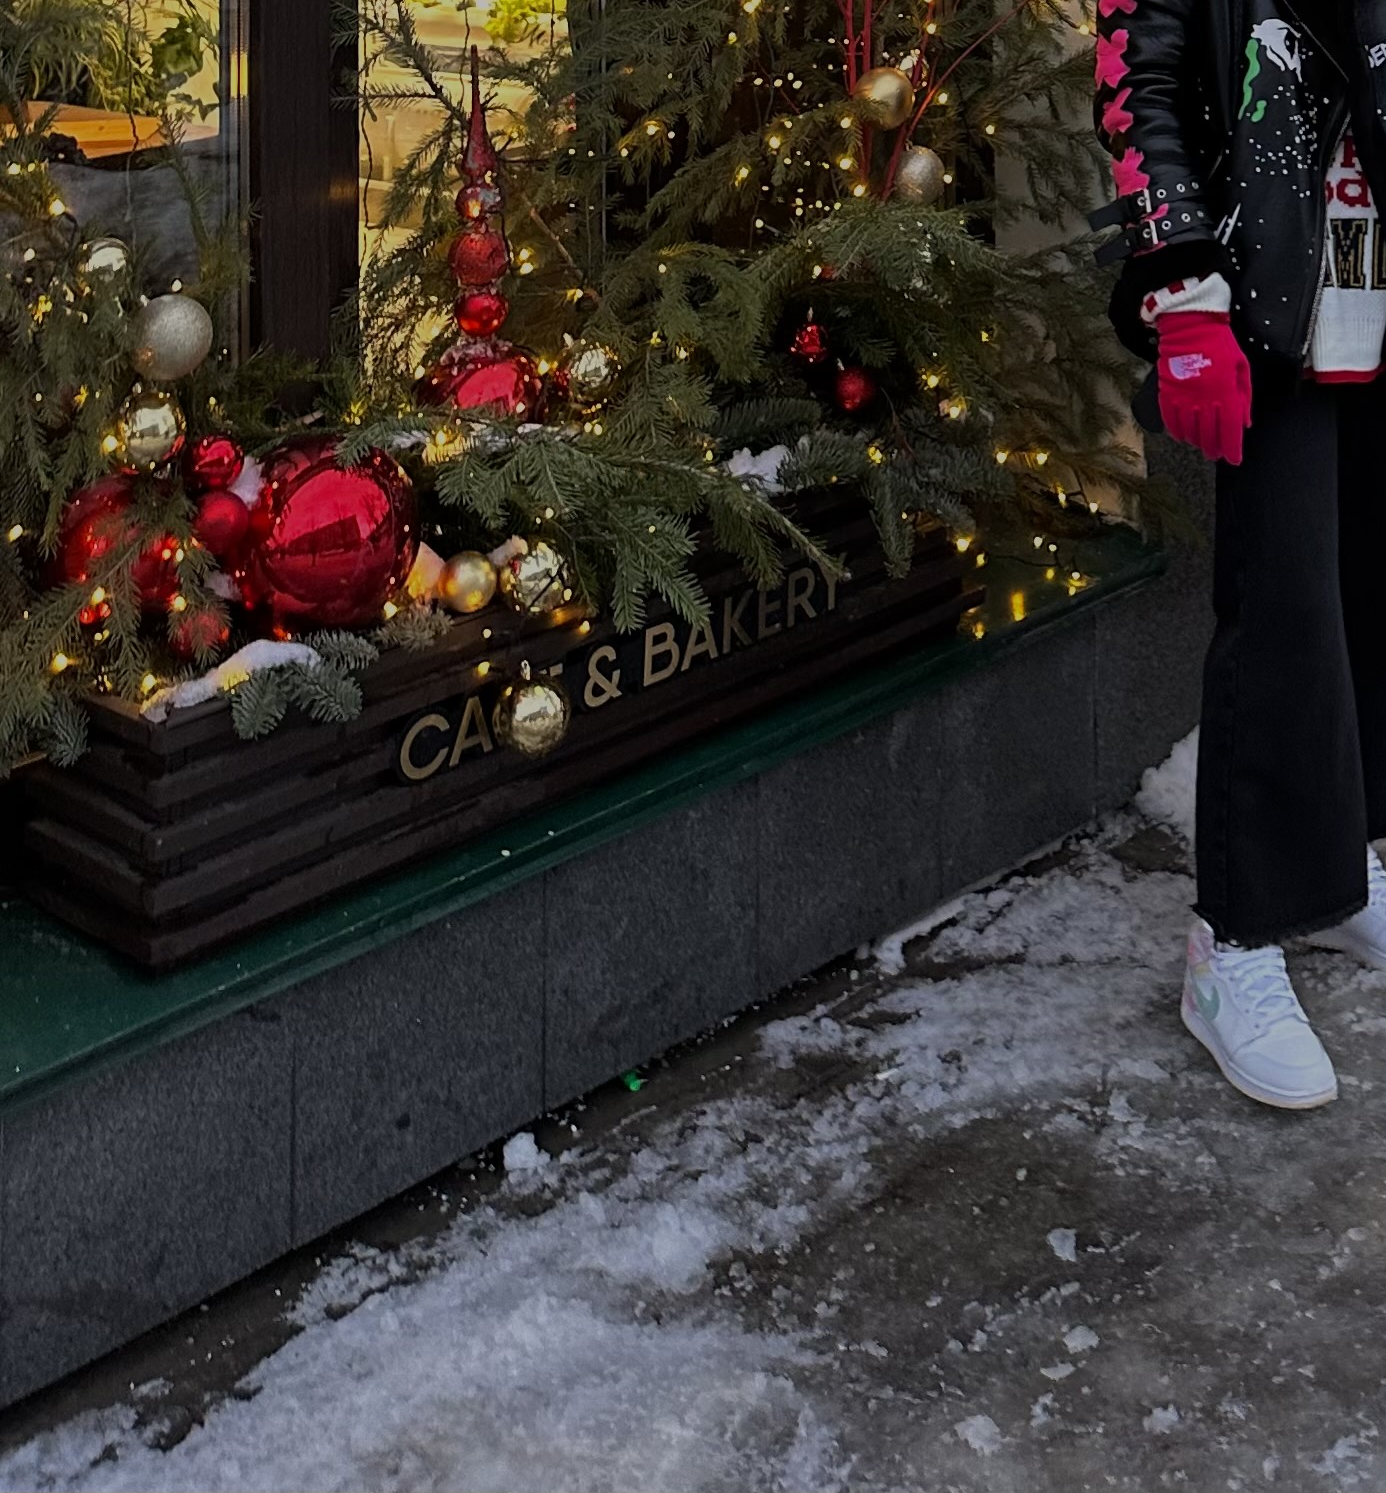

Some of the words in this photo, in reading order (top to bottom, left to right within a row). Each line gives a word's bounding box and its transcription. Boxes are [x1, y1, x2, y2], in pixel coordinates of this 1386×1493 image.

[400, 664, 564, 780] CA
[582, 644, 623, 708] &
[643, 554, 845, 687] BAKERY
